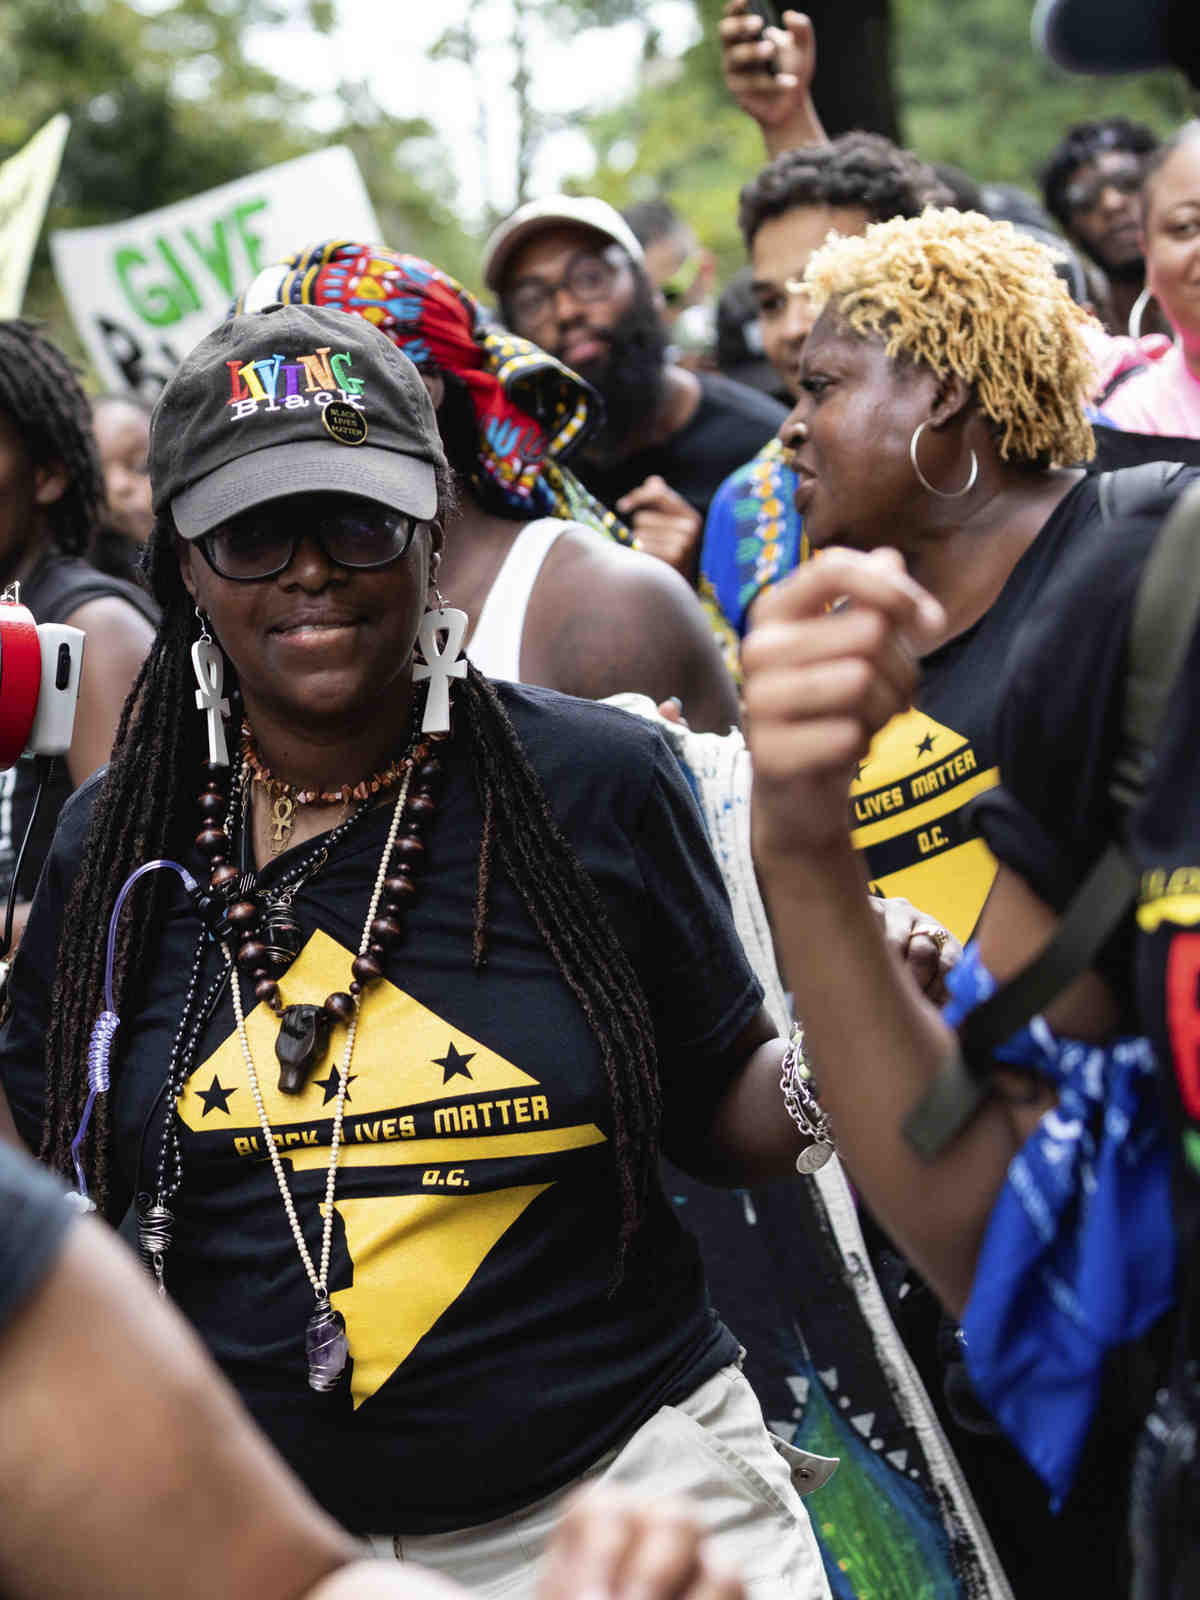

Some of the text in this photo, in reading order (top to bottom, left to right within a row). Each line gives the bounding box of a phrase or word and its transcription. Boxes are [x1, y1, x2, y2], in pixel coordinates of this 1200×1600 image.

[112, 196, 268, 328] GIVE
[226, 346, 366, 406] LIVING
[230, 388, 366, 421] Black
[329, 407, 357, 419] BLACK
[330, 424, 363, 437] MATTER
[333, 416, 359, 428] LIVES
[855, 749, 977, 820] LIVES MATTER
[917, 826, 950, 854] D.C.
[433, 1095, 550, 1135] MATTER
[422, 1168, 470, 1187] D.C.
